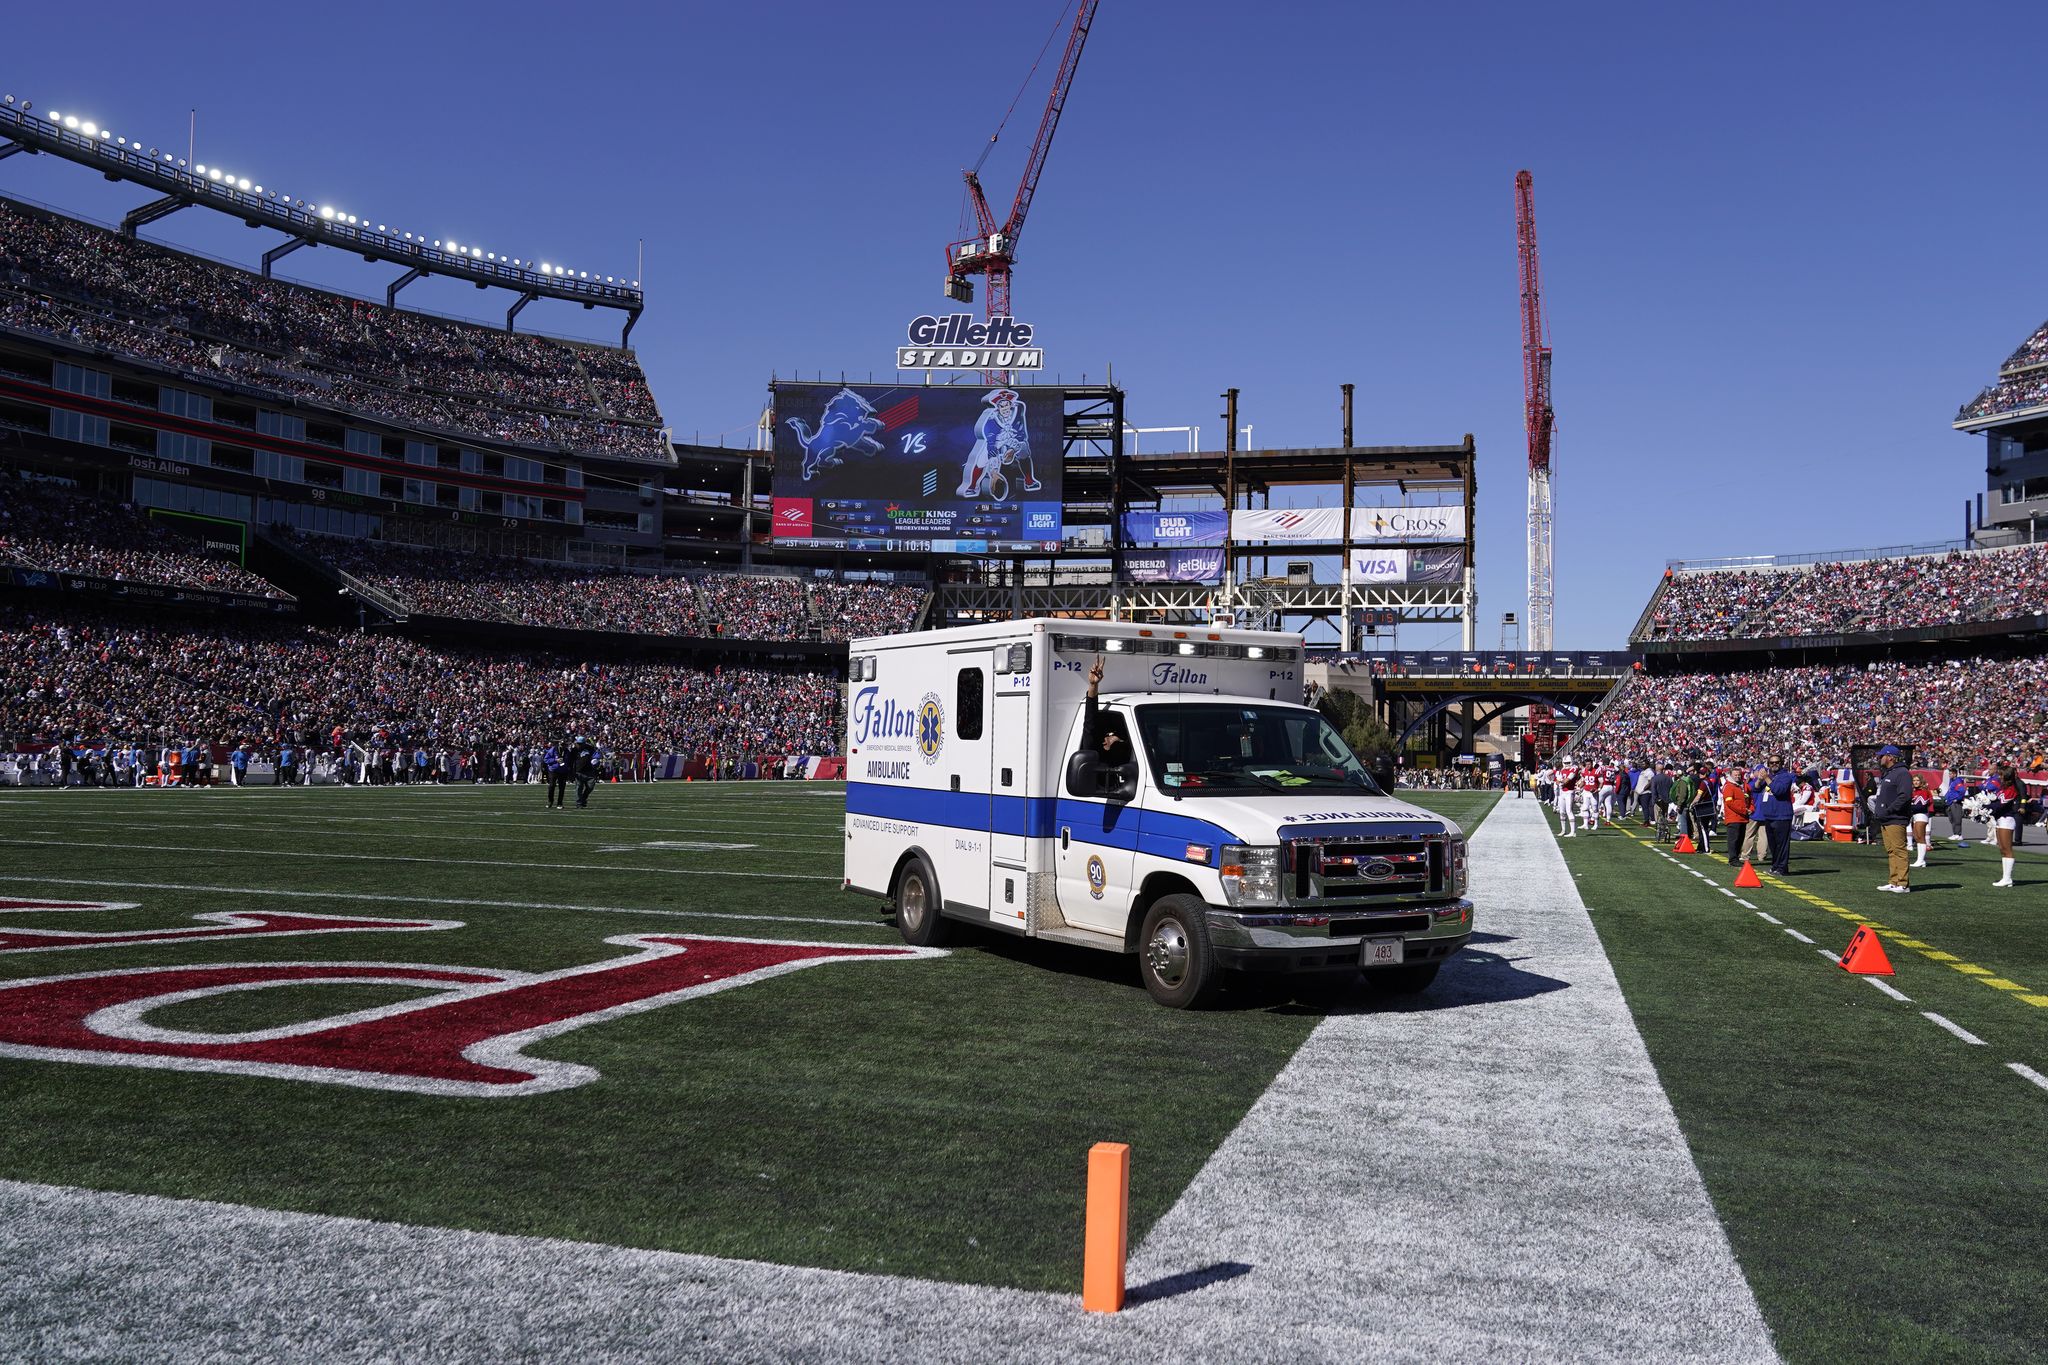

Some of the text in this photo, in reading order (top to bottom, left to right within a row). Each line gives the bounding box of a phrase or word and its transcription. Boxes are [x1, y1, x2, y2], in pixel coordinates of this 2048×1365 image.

[908, 314, 1033, 347] Gillette
[902, 351, 1039, 367] STADIUM
[128, 455, 190, 476] Josh Allen
[311, 489, 326, 500] 98
[392, 502, 397, 513] 1
[451, 512, 459, 521] 0
[887, 510, 957, 520] DRAFTKINGS
[502, 518, 518, 528] 7.9
[1159, 517, 1186, 527] BUD
[1155, 527, 1192, 537] LIGHT
[206, 540, 240, 553] PATRIOTS
[887, 540, 893, 551] 0
[905, 540, 931, 551] 10:15
[1044, 542, 1057, 551] 40
[1177, 559, 1217, 574] jetBlue
[1356, 559, 1398, 575] VISA
[129, 587, 148, 596] PASS
[148, 588, 164, 597] YDS
[185, 593, 204, 602] RUSH
[205, 595, 220, 603] YDS
[1792, 637, 1844, 649] Putnam
[1054, 661, 1082, 672] P-12
[1152, 662, 1207, 686] Fallon
[1269, 670, 1293, 681] P-12
[1013, 676, 1031, 688] P-12
[854, 686, 915, 744] Fallon
[867, 760, 910, 780] AMBULANCE
[853, 818, 919, 837] ADVANCED LIFE SUPPORT
[955, 839, 982, 853] DIAL 9-1-1
[1090, 864, 1102, 879] 90
[1375, 945, 1392, 959] 483
